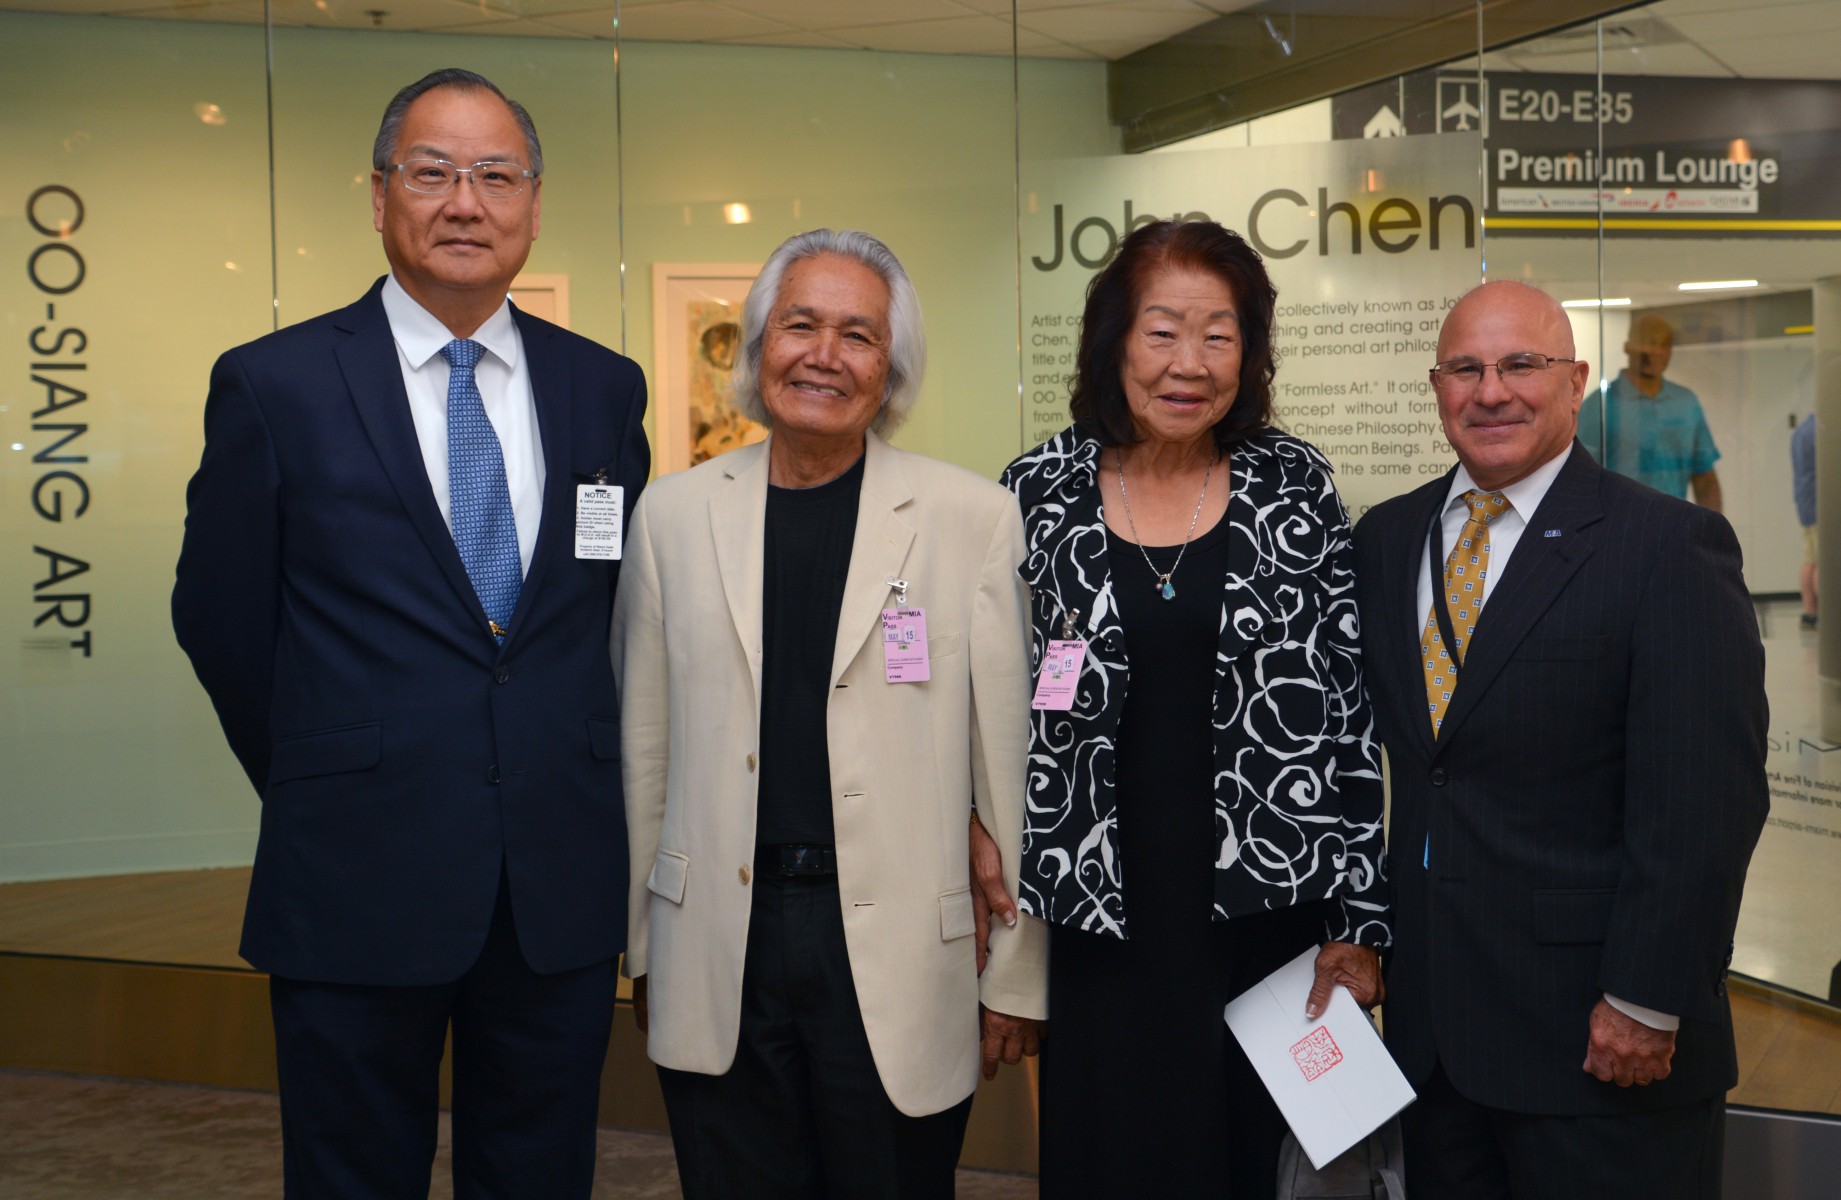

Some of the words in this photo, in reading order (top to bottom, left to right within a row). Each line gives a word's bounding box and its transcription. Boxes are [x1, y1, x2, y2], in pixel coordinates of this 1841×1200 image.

[1499, 89, 1633, 124] E20-E35
[1498, 149, 1645, 182] Premium
[1657, 151, 1779, 191] Lounge
[1247, 187, 1476, 260] Chen
[1275, 301, 1360, 318] collectively
[1364, 299, 1412, 314] known
[1417, 299, 1435, 312] as
[1439, 297, 1462, 312] Jo
[1031, 314, 1062, 328] Artist
[1273, 324, 1308, 339] hing
[1313, 322, 1344, 336] and
[1350, 319, 1413, 335] creating
[1418, 318, 1439, 332] art
[26, 184, 91, 523] OO-SIANG
[1302, 341, 1366, 359] personal
[1370, 341, 1390, 354] art
[1394, 338, 1438, 356] philos
[1032, 353, 1055, 366] title
[1058, 353, 1072, 366] of
[1032, 373, 1059, 385] and
[1387, 381, 1395, 394] It
[1399, 380, 1434, 397] origi
[1345, 401, 1398, 415] without
[1033, 411, 1063, 423] from
[1033, 430, 1060, 442] ulti
[1294, 422, 1353, 437] Chinese
[1356, 419, 1435, 437] Philosophy
[1316, 443, 1369, 456] Human
[1372, 441, 1424, 458] Beings.
[1340, 461, 1364, 476] the
[1370, 460, 1412, 475] same
[32, 545, 92, 658] ART
[888, 633, 899, 641] MAY
[905, 630, 914, 640] 15
[1065, 659, 1072, 669] 15
